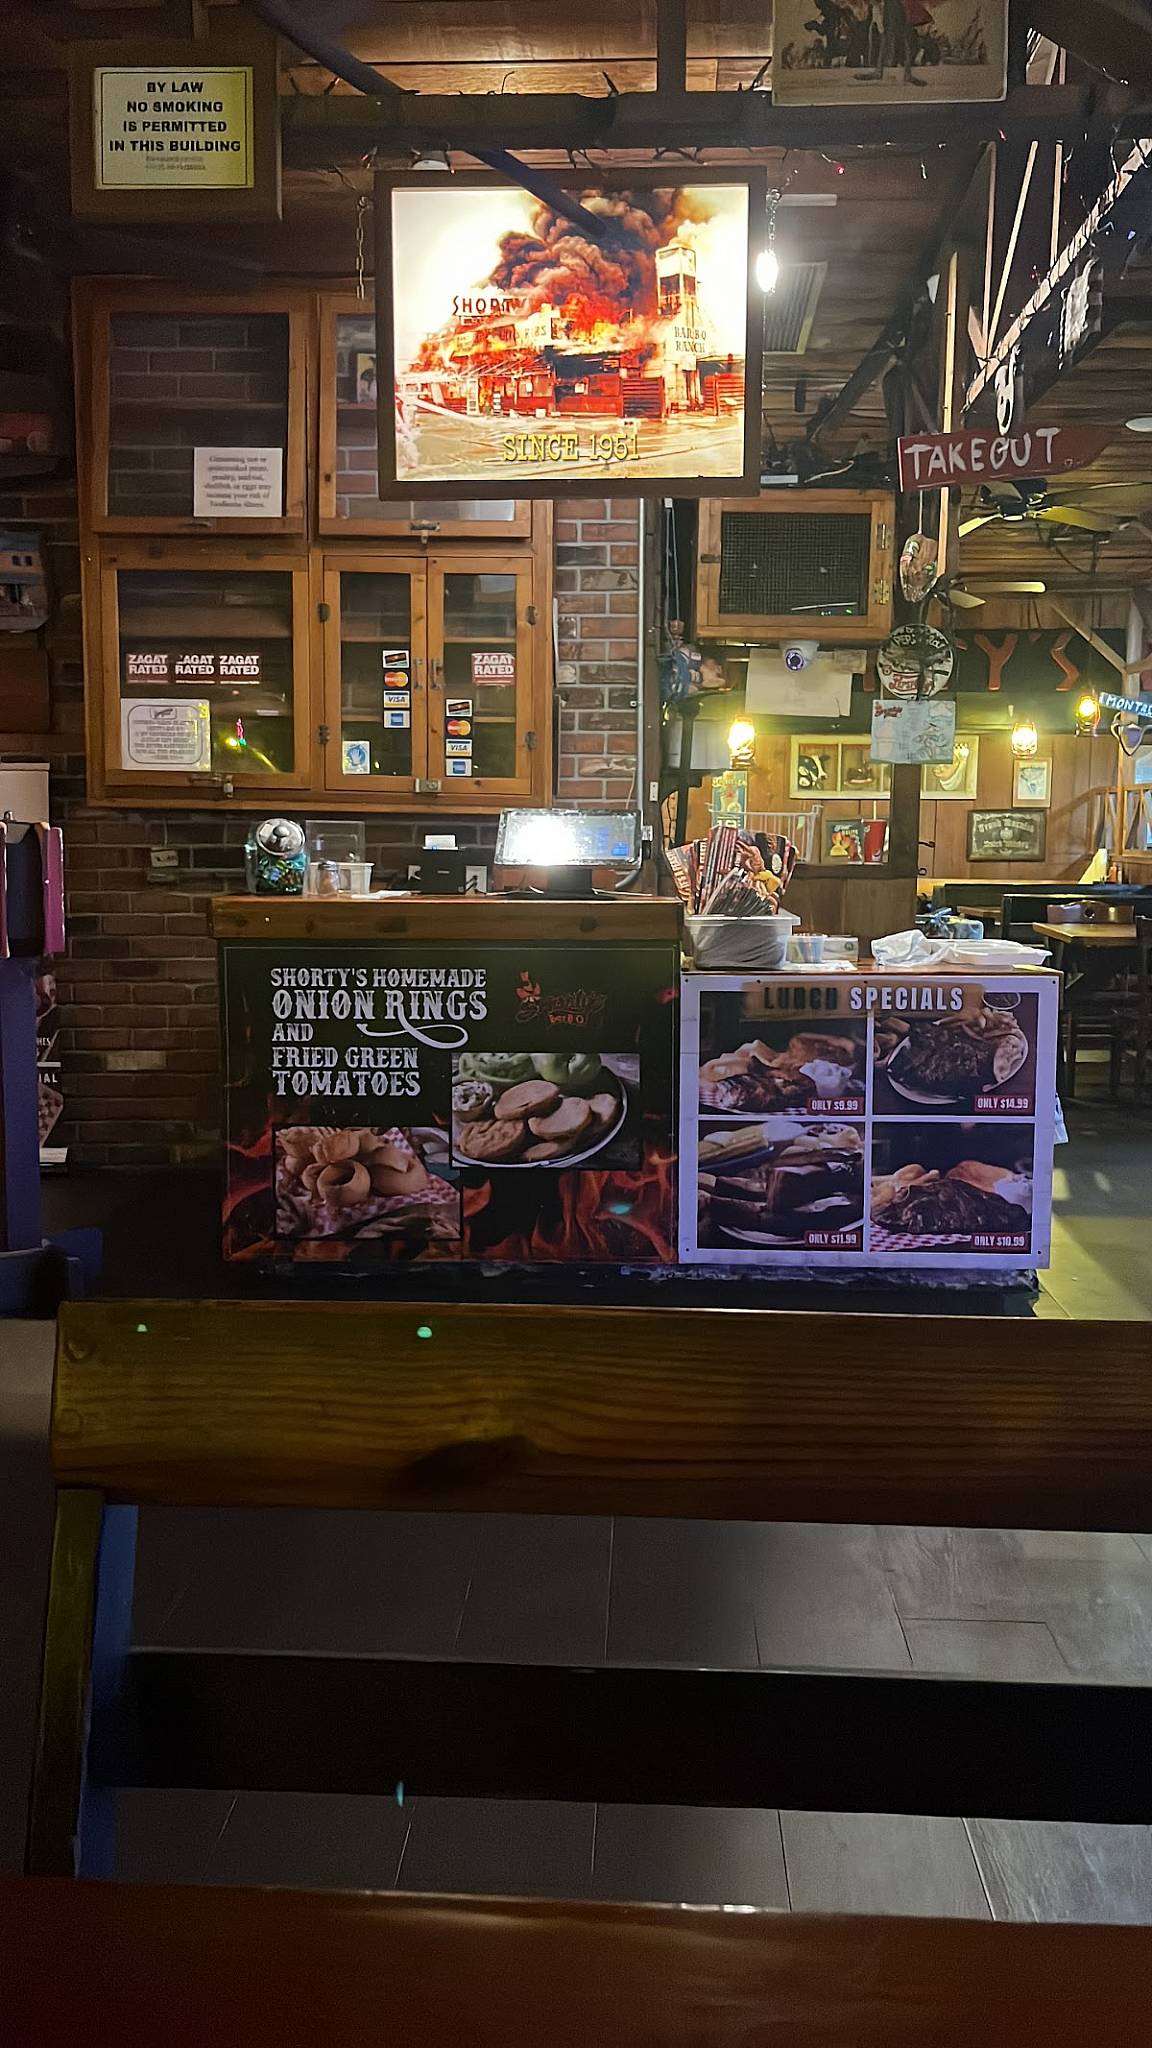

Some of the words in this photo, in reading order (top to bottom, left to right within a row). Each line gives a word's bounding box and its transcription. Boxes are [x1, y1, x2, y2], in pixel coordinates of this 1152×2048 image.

[147, 82, 166, 93] BY
[171, 82, 203, 93] LAW
[127, 101, 148, 112] NO
[153, 101, 223, 112] SMOKING
[123, 121, 137, 132] IS
[142, 121, 227, 132] PERMITTED
[109, 140, 125, 151] IN
[130, 140, 164, 151] THIS
[169, 140, 241, 152] BUILDING
[503, 433, 579, 461] SINCE
[590, 433, 640, 461] 1951
[129, 654, 168, 665] ZAGAT
[220, 655, 260, 665] ZAGAT
[474, 655, 514, 665] ZAGAT
[129, 664, 168, 675] RATED
[175, 664, 215, 675] RATED
[220, 664, 260, 676] RATED
[474, 665, 514, 675] RATED
[270, 968, 368, 987] SHORTY'S
[372, 968, 486, 988] HOMEMADE
[272, 989, 375, 1020] ONION
[850, 987, 963, 1011] SPECIALS
[272, 1023, 314, 1042] AND
[272, 1046, 339, 1068] FRIED
[345, 1047, 419, 1069] GREEN
[273, 1070, 421, 1096] TOMATOES
[811, 1099, 832, 1111] ONLY
[833, 1100, 858, 1111] $9.99
[977, 1098, 998, 1109] ONLY
[1000, 1097, 1029, 1109] $14.99
[808, 1233, 829, 1244] ONLY
[830, 1233, 857, 1244] $11.99
[974, 1234, 995, 1246] ONLY
[996, 1234, 1025, 1246] $10.99
